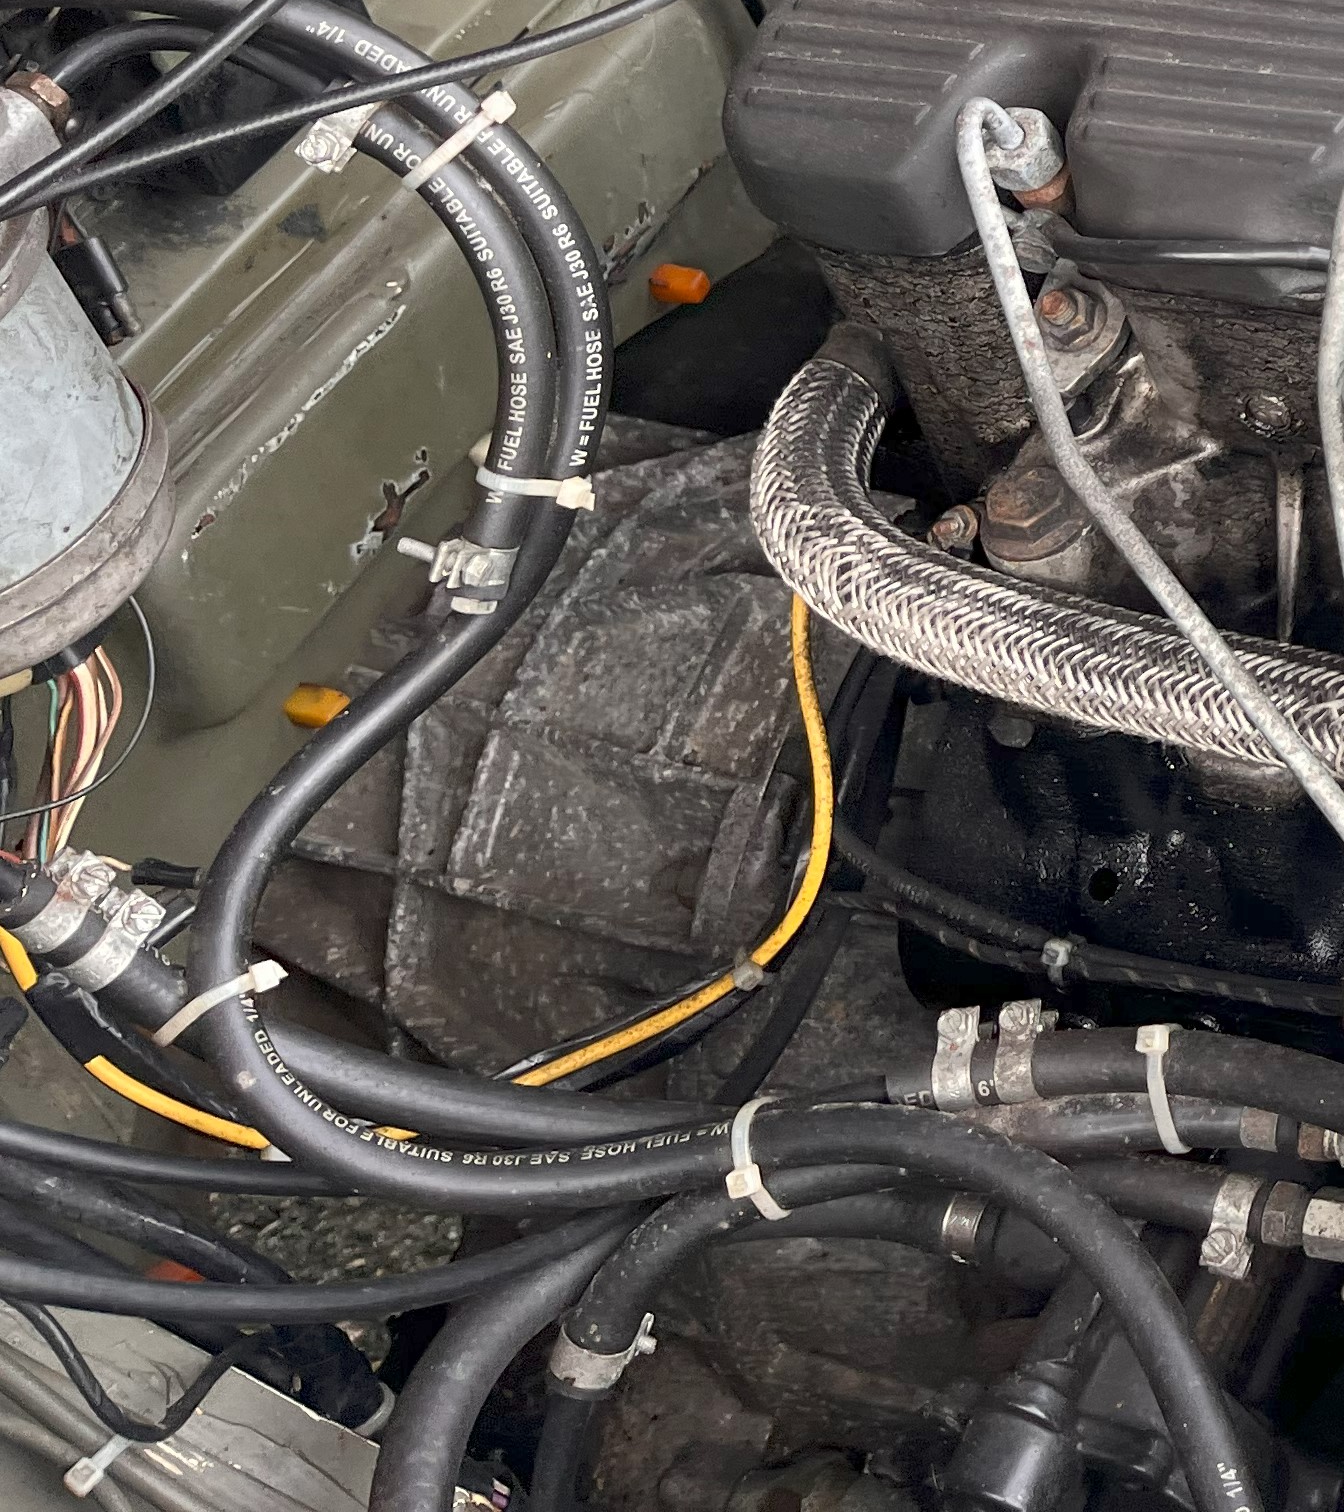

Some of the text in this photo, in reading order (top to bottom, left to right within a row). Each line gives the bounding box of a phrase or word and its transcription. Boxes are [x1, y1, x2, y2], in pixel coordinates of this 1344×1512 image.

[305, 20, 346, 45] 1/4"
[354, 39, 456, 113] UNADED
[487, 137, 559, 220] SUITABLE
[428, 176, 494, 263] SUITABLE
[576, 282, 599, 322] SAE
[505, 326, 526, 365] SAE
[585, 329, 602, 381] HOSE
[508, 372, 528, 422] HOSE
[579, 383, 601, 431] FUEL
[497, 425, 523, 471] FUEL
[569, 449, 588, 467] W
[254, 1029, 329, 1113] UNLEADED
[322, 1110, 359, 1135] FOR
[646, 1131, 690, 1150] FUEL
[710, 1121, 730, 1137] W
[360, 1131, 454, 1163] SUITABLE
[530, 1150, 570, 1164] SAE
[580, 1140, 636, 1161] HOSE
[1216, 1462, 1243, 1499] 1/4"
